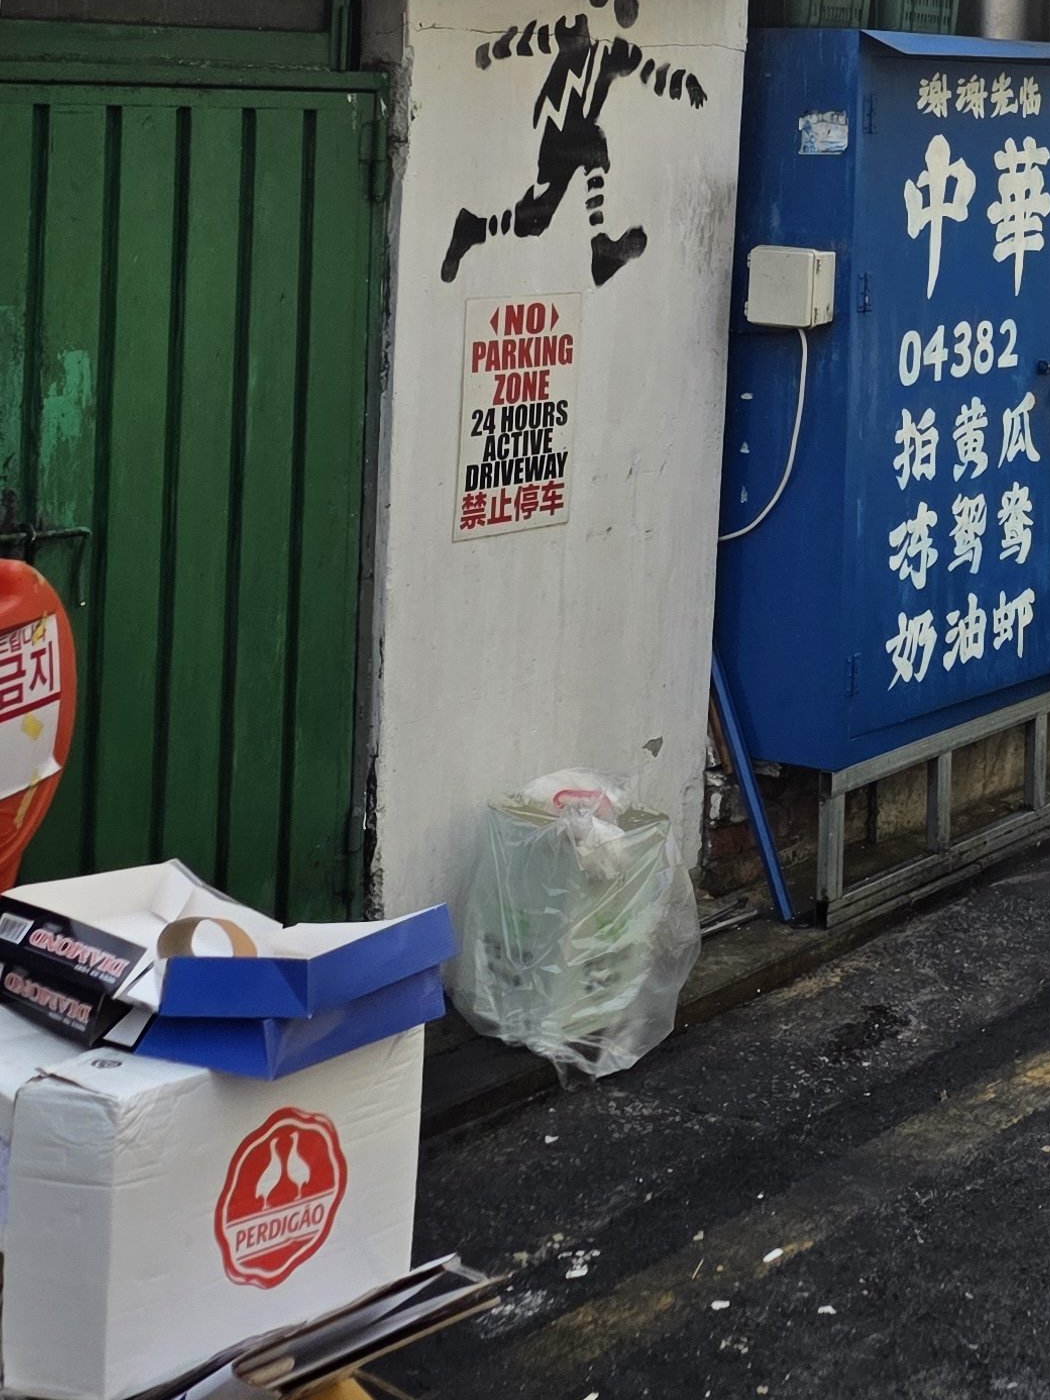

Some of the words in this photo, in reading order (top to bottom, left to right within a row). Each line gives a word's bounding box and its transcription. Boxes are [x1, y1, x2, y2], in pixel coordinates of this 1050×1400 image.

[504, 303, 546, 336] NO
[471, 334, 573, 373] PARKING
[900, 318, 1018, 387] 04382
[493, 370, 550, 405] ZONE
[471, 408, 495, 437] 24
[501, 400, 568, 433] HOURS
[483, 428, 553, 462] ACTIVE
[893, 391, 1040, 490] 拍黄瓜
[465, 451, 568, 492] DRIVEWAY
[459, 481, 564, 530] 禁止停车
[886, 587, 1036, 691] 奶油虾
[235, 1203, 325, 1252] PERDIGÃO
